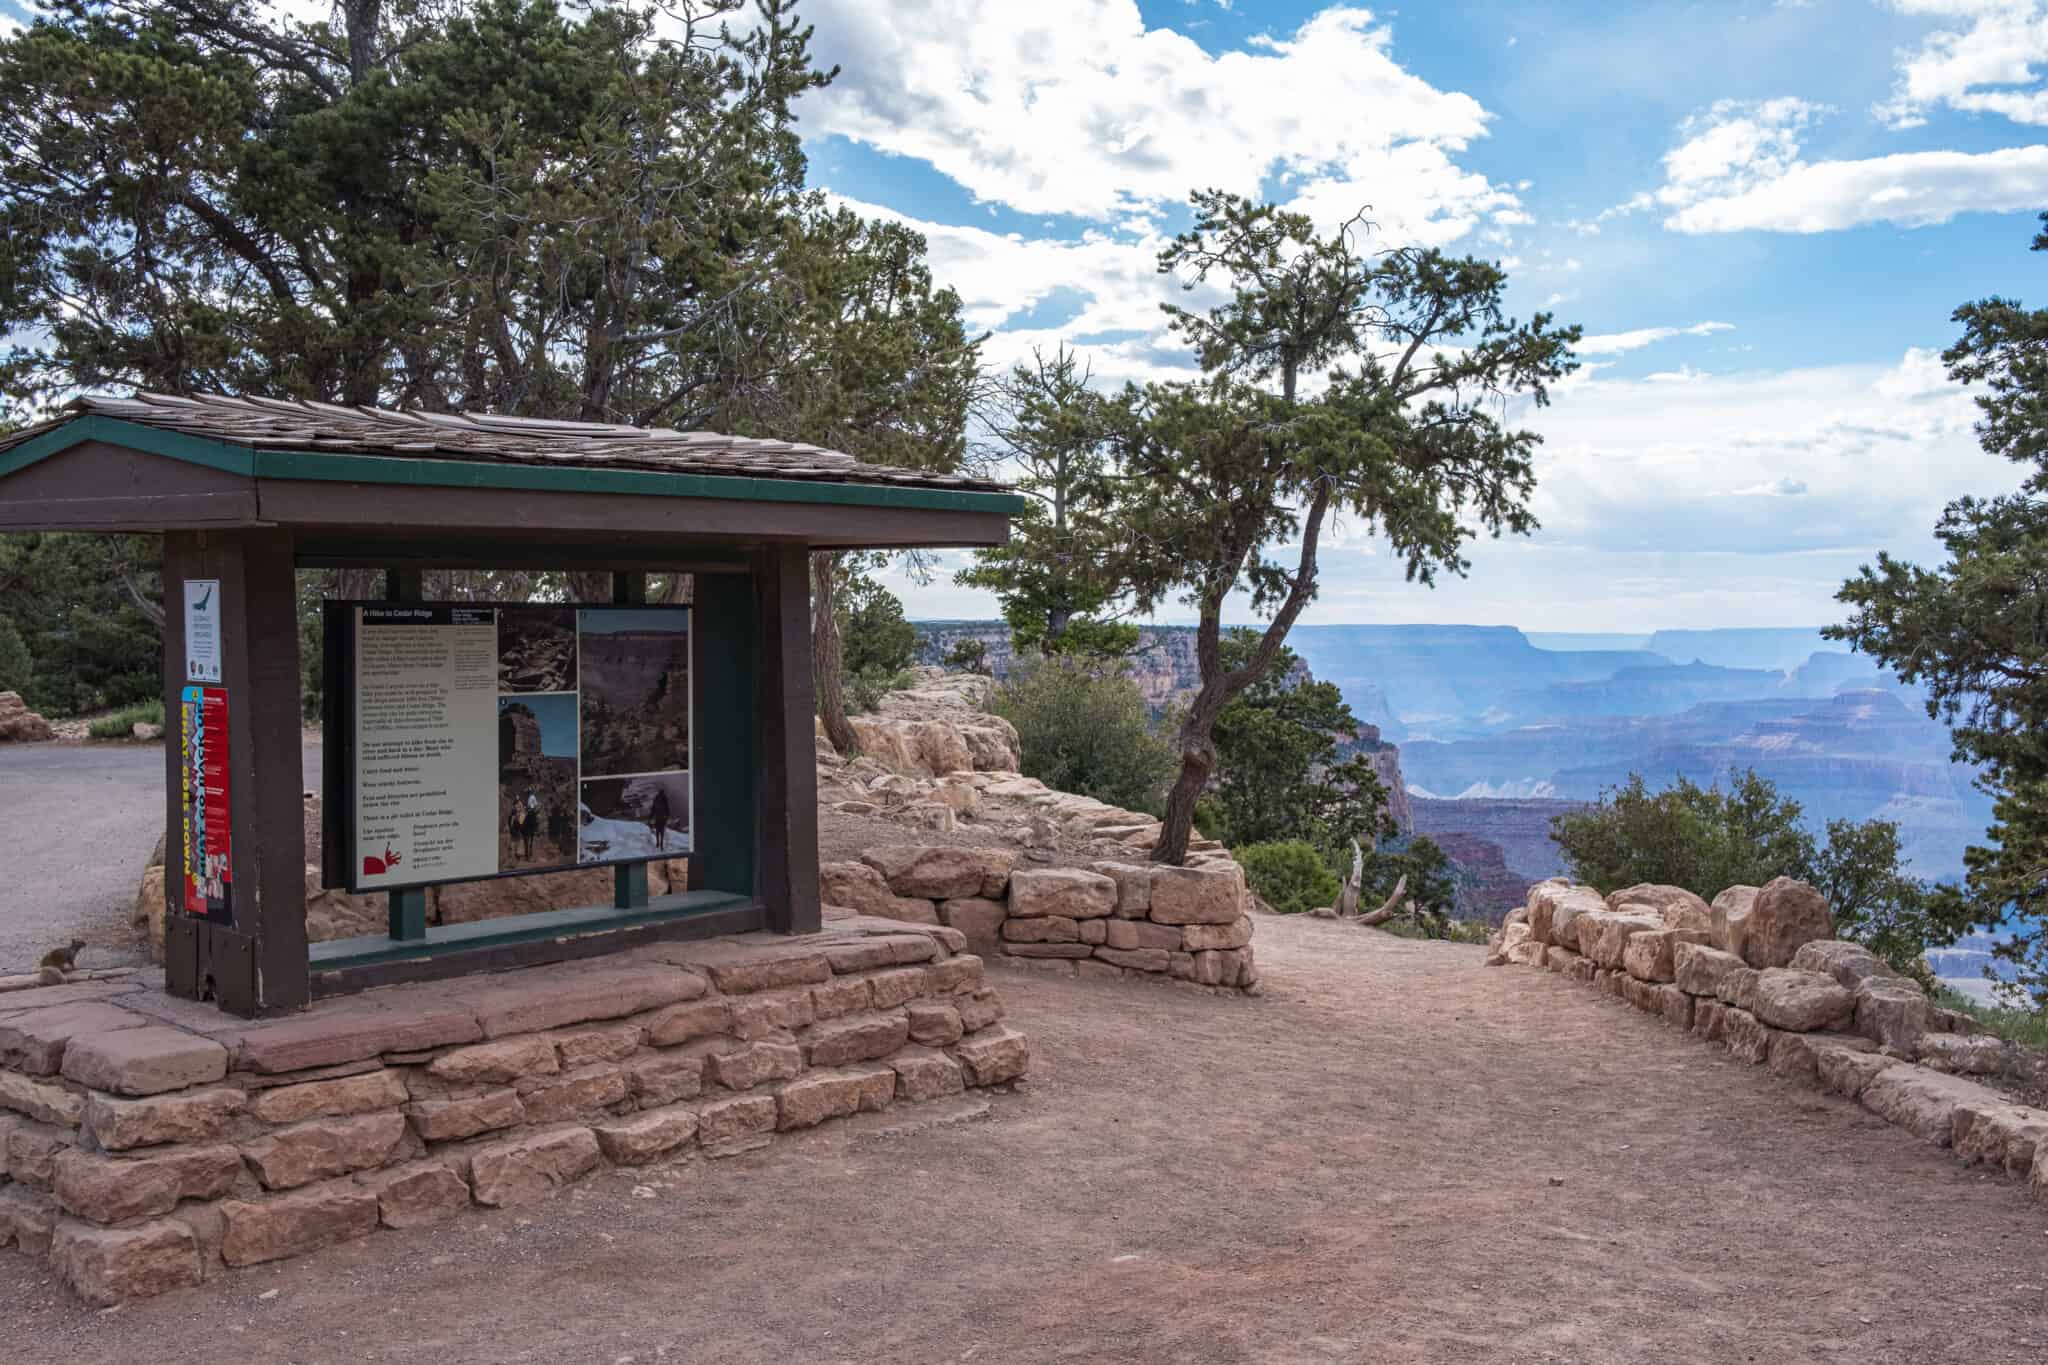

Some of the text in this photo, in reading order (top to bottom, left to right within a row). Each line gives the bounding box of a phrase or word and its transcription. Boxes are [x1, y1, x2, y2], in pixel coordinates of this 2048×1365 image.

[363, 609, 433, 618] A Hike to Cedar Ridge
[182, 703, 190, 758] WHAT
